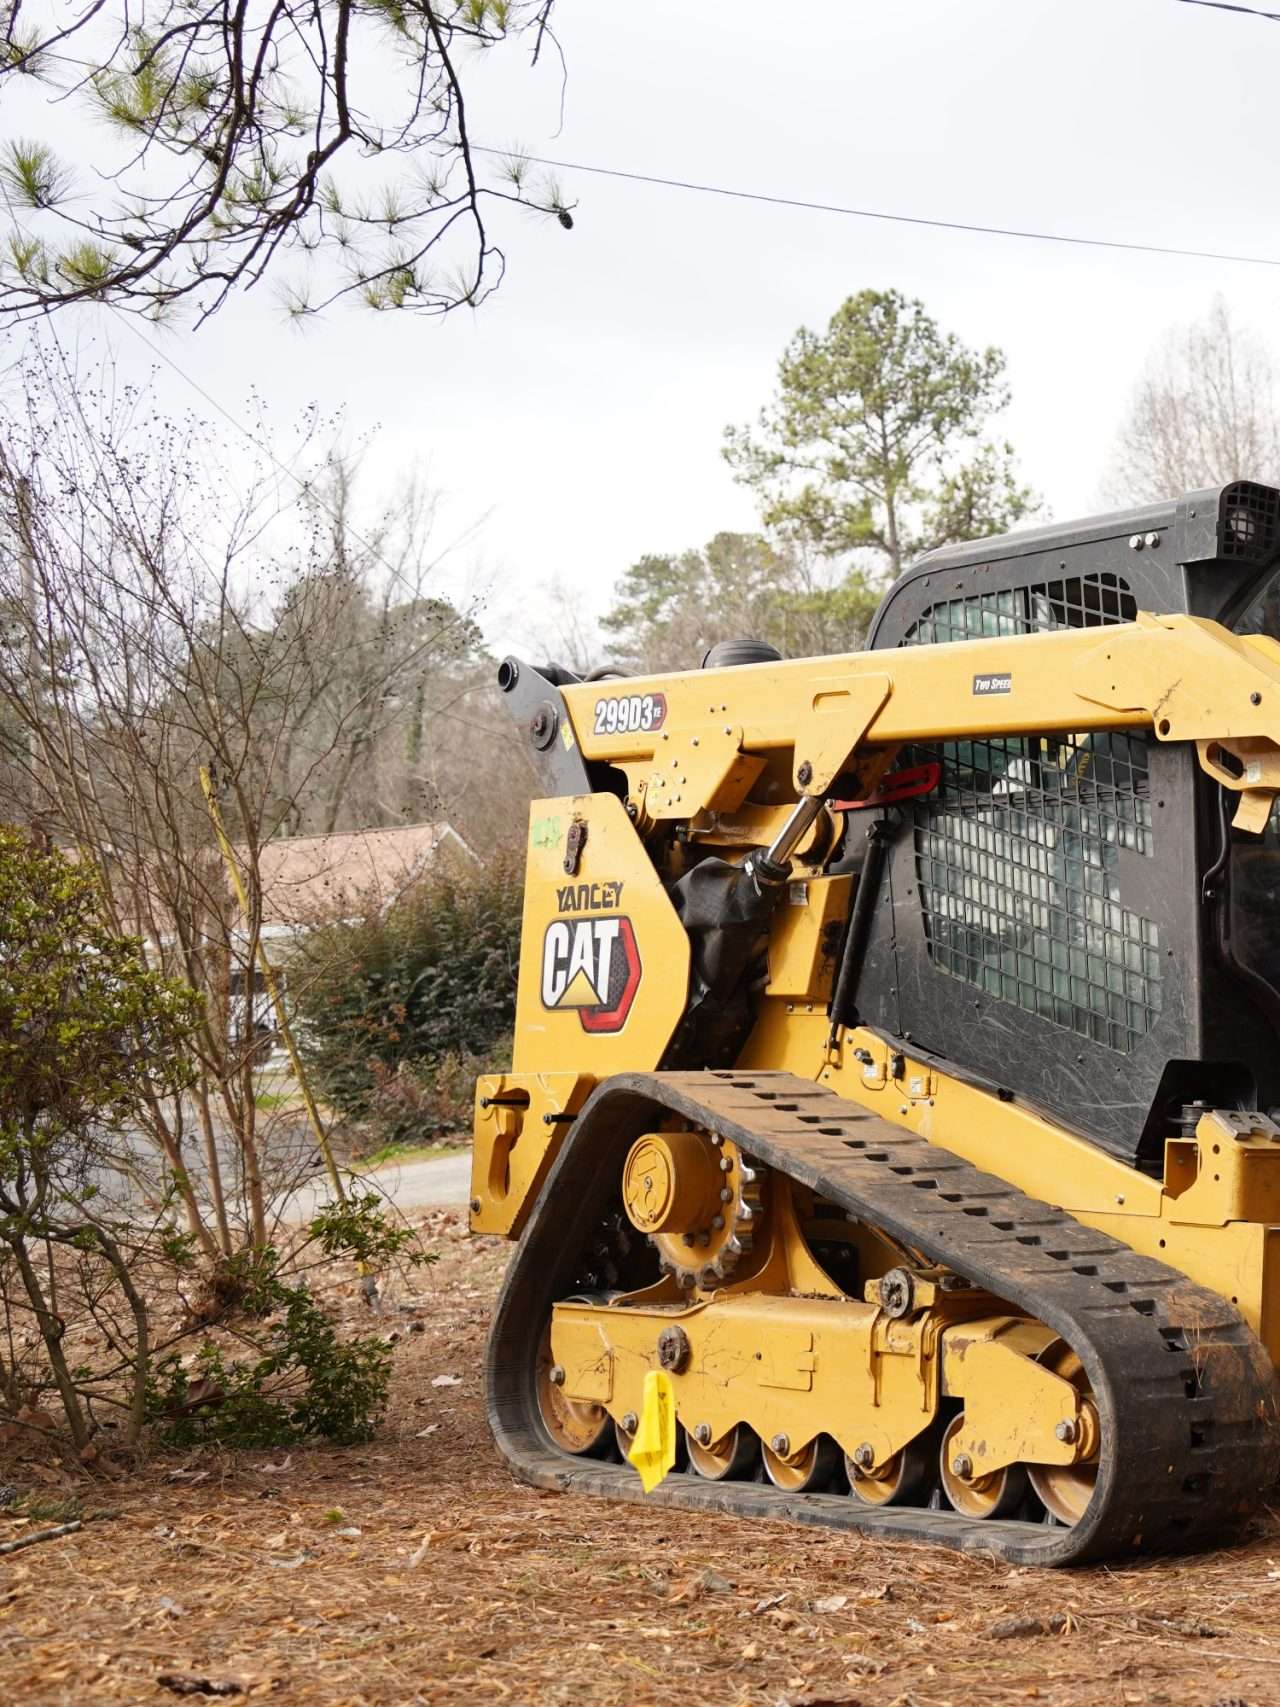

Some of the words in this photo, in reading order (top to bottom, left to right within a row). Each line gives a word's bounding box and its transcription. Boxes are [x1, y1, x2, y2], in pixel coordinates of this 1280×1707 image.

[594, 696, 654, 735] 299D3
[557, 881, 624, 912] YANCEY
[541, 919, 619, 1008] CAT
